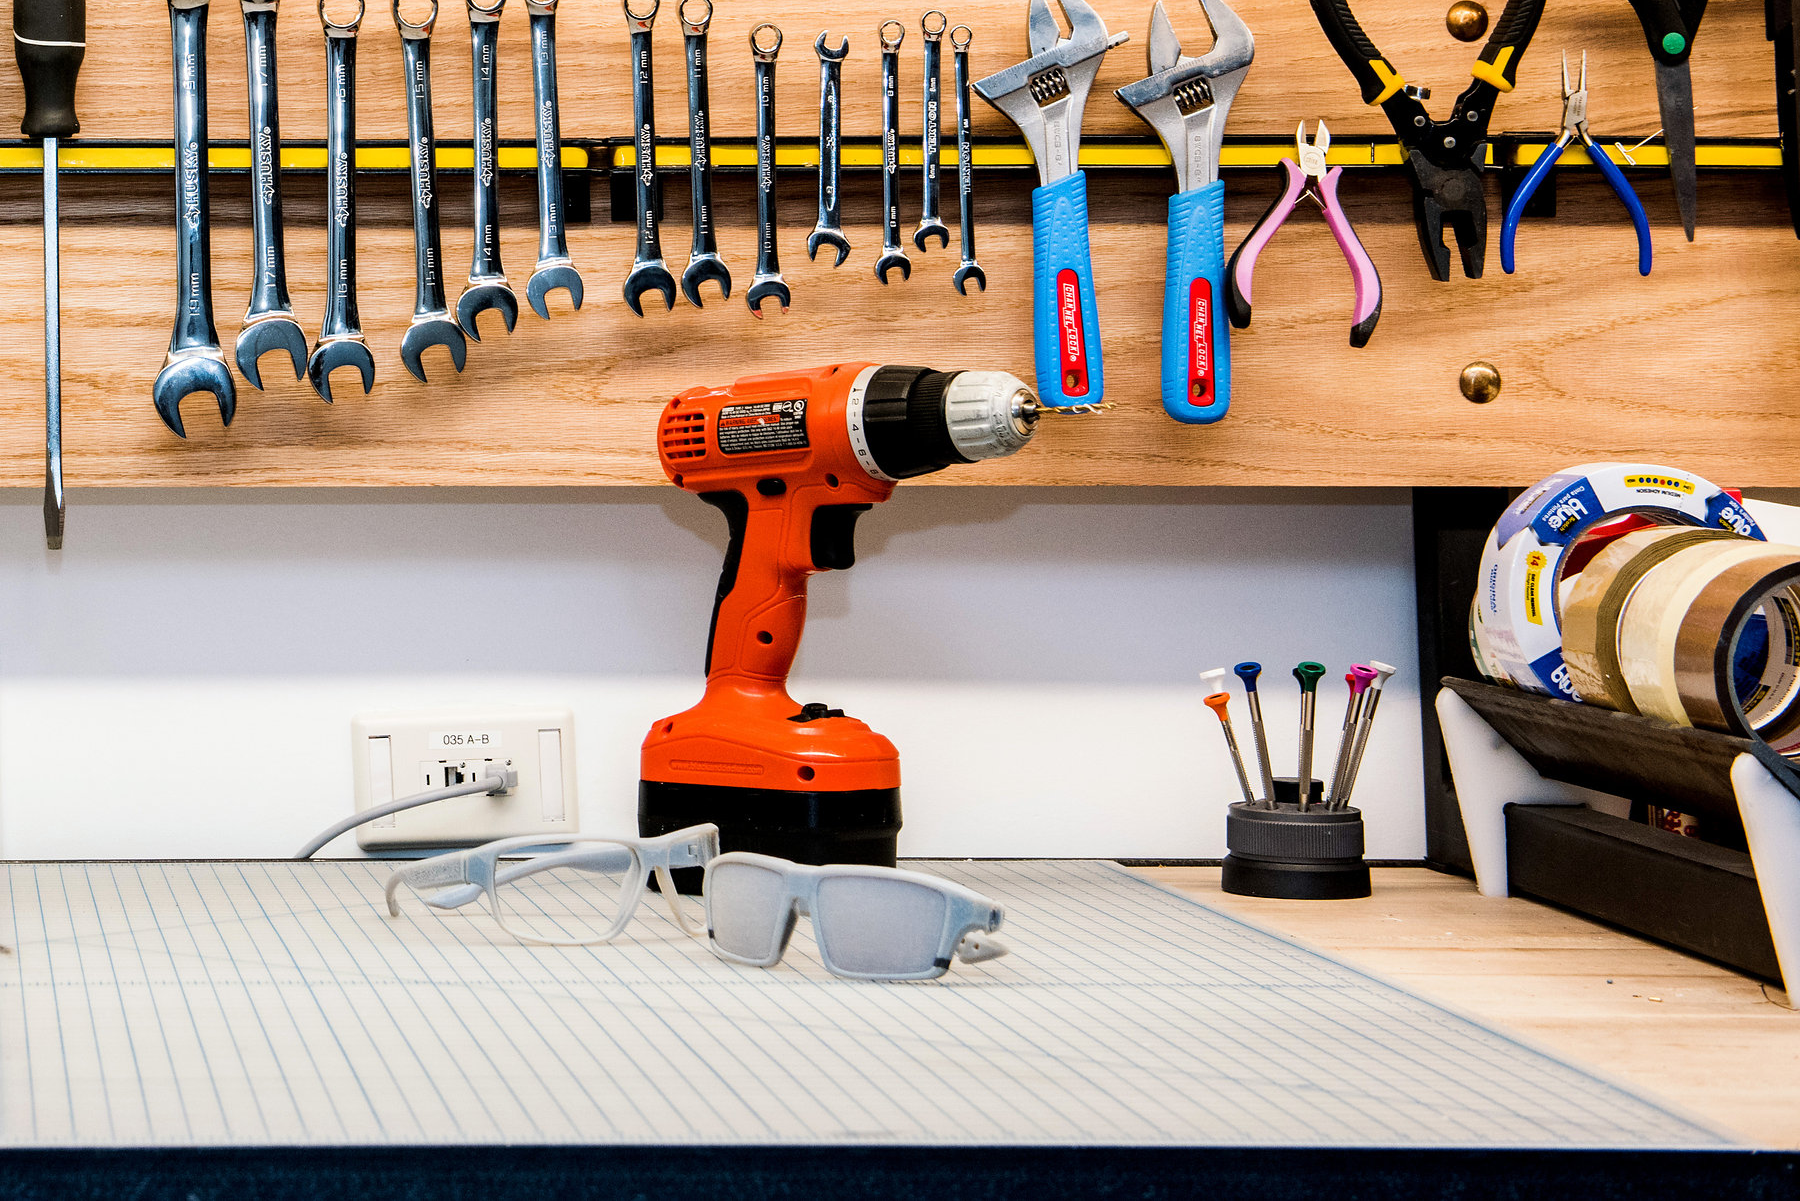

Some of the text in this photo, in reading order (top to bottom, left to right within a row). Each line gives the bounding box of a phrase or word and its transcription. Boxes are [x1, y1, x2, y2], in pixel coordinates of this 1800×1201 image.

[415, 60, 425, 98] 15 mm
[481, 44, 490, 82] 14 mm
[640, 50, 649, 85] 12 mm
[762, 76, 770, 108] 10 mm
[481, 122, 492, 170] HUSKY
[542, 105, 554, 151] HUSKY
[928, 101, 938, 154] TEKTON
[260, 132, 274, 188] HUSKY
[417, 142, 430, 191] HUSKY
[641, 127, 652, 172] HUSKY
[963, 141, 972, 195] TEKTON
[184, 148, 200, 210] HUSKY
[336, 158, 349, 209] HUSKY
[549, 203, 558, 239] 13 mm
[700, 205, 709, 235] 11 mm
[265, 245, 276, 287] 17 mm
[852, 423, 860, 432] 4
[1636, 488, 1660, 497] ADHESION
[1547, 498, 1589, 530] blue
[1559, 516, 1576, 535] Scotch
[1530, 555, 1541, 567] 14
[443, 734, 490, 745] 035 A-B
